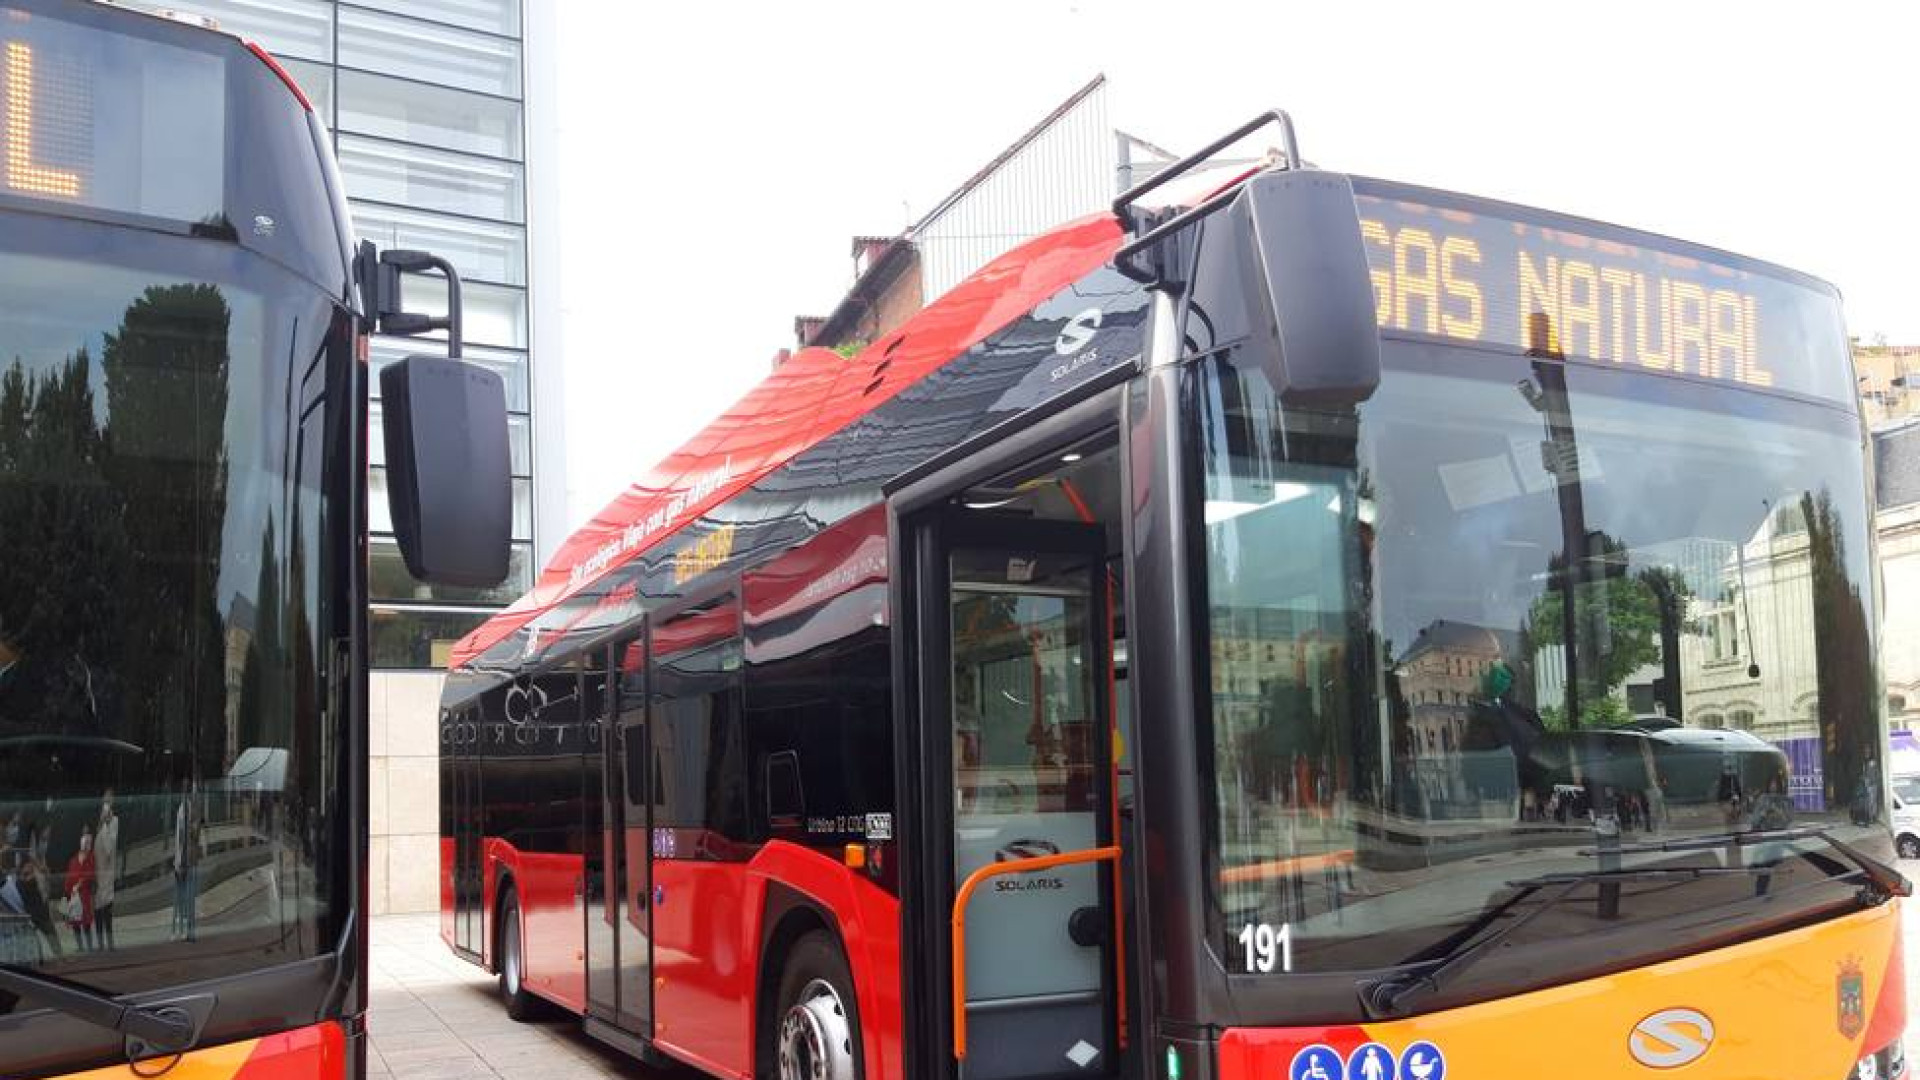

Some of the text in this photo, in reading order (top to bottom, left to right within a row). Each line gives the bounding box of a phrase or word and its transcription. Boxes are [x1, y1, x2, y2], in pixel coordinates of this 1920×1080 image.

[8, 43, 79, 196] L
[1362, 219, 1773, 387] GAS NATURAL
[995, 878, 1064, 892] SOLARIS
[1239, 922, 1291, 973] 191
